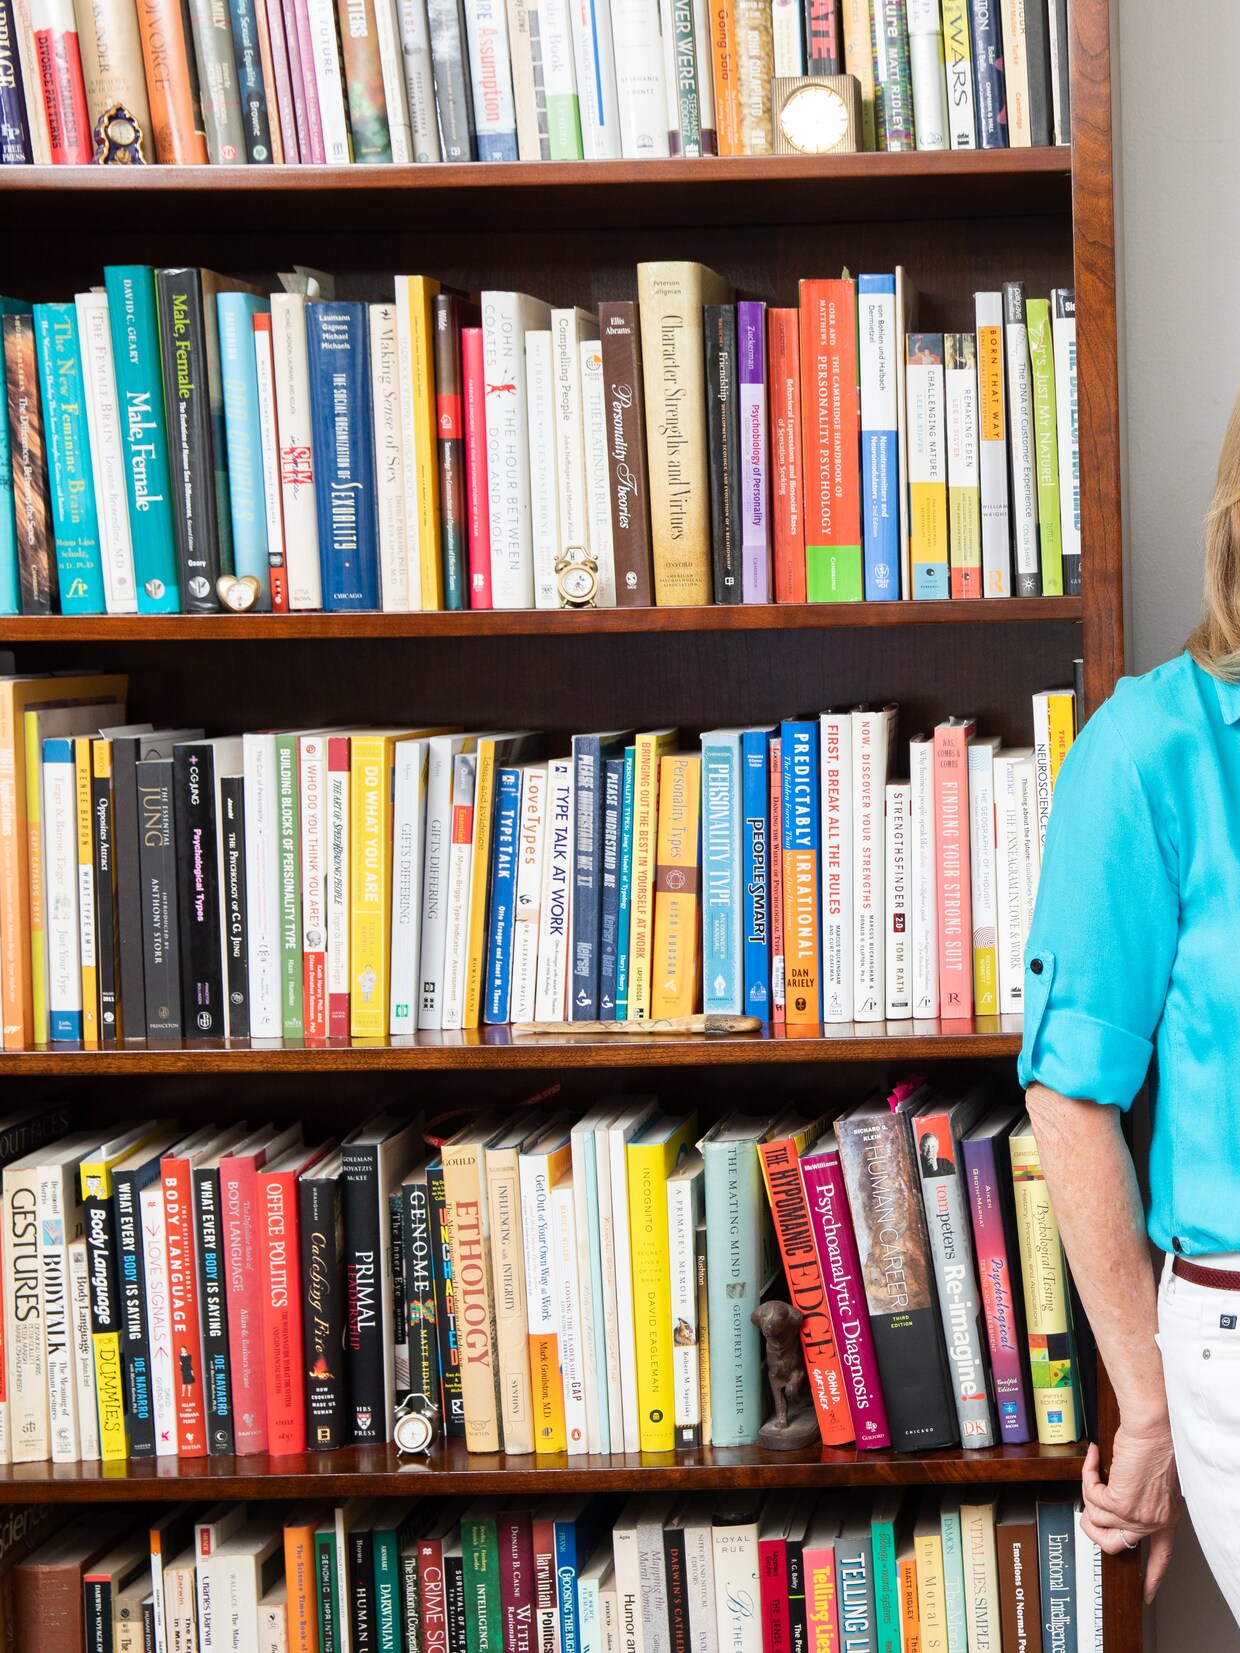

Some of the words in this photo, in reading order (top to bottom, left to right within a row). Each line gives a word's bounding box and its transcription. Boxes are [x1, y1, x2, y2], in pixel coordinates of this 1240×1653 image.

[241, 17, 252, 46] Sexual
[717, 10, 728, 48] Going
[242, 50, 255, 87] Equality
[479, 28, 503, 122] Assumption
[721, 53, 730, 80] Solo
[888, 48, 899, 80] MATT
[950, 14, 967, 106] WARS
[38, 36, 51, 87] DIVORCE
[46, 89, 61, 148] PATTERNS
[677, 38, 694, 90] WERE
[688, 93, 698, 140] STEPHANIE
[891, 85, 902, 131] RIDLEY
[681, 99, 691, 136] COONTZ
[123, 280, 134, 312] DAVID
[172, 294, 188, 337] Male,
[54, 321, 71, 352] The
[128, 327, 138, 364] GEARY
[660, 315, 684, 384] Character
[747, 326, 756, 370] Zuckerman
[58, 358, 75, 396] New
[177, 341, 194, 398] Female
[333, 374, 345, 387] THE
[718, 352, 729, 401] Friendship
[126, 390, 157, 442] Male,
[334, 389, 347, 414] SOCIAL
[504, 408, 516, 436] THE
[611, 384, 632, 462] Personality
[658, 388, 689, 456] Strengths
[818, 356, 829, 446] PERSONALITY
[833, 376, 841, 430] CAMBRIDGE
[61, 403, 79, 473] Feminine
[335, 417, 350, 467] ORGANIZATION
[489, 428, 499, 461] DOG
[750, 405, 761, 466] Psychobiology
[834, 432, 842, 483] HANDBOOK
[133, 444, 162, 511] Female
[338, 470, 350, 479] OF
[491, 472, 500, 503] AND
[506, 445, 517, 489] HOUR
[667, 460, 688, 485] and
[754, 467, 761, 477] of
[871, 436, 879, 499] Neuromodulators
[880, 436, 888, 500] Neurotransmitters
[69, 480, 85, 523] Brain
[617, 463, 638, 529] Theories
[752, 478, 762, 526] Personality
[819, 449, 831, 534] PSYCHOLOGY
[835, 486, 842, 497] OF
[331, 482, 363, 549] SEXUALITY
[492, 511, 502, 556] WOLF
[507, 498, 519, 570] BETWEEN
[669, 490, 691, 540] Virtues
[827, 724, 838, 764] FIRST,
[280, 749, 292, 794] BUILDING
[365, 766, 378, 786] DO
[793, 733, 811, 846] PREDICTABLY
[828, 769, 839, 813] BREAK
[98, 798, 108, 840] Opposites
[138, 786, 163, 848] JUNG
[282, 797, 293, 835] BLOCKS
[365, 790, 378, 834] WHAT
[523, 774, 543, 864] LoveTypes
[555, 786, 569, 820] TYPE
[709, 764, 731, 863] PERSONALITY
[942, 781, 958, 837] FINDING
[283, 838, 294, 850] OF
[553, 826, 568, 861] TALK
[828, 817, 839, 840] ALL
[894, 792, 905, 908] STRENGTHSFINDER
[101, 842, 109, 870] Attract
[193, 829, 204, 891] Psychological
[229, 850, 239, 898] PSYCHOLOGY
[365, 837, 378, 868] YOU
[552, 865, 566, 883] AT
[829, 843, 840, 870] THE
[943, 843, 959, 877] YOUR
[151, 878, 162, 927] ANTHONY
[195, 894, 205, 921] Types
[232, 901, 239, 911] OF
[283, 853, 295, 921] PERSONALITY
[364, 872, 378, 902] ARE
[709, 869, 730, 906] TYPE
[797, 855, 813, 958] IRRATIONAL
[829, 873, 840, 915] RULES
[943, 883, 961, 934] STRONG
[233, 924, 241, 933] G.
[550, 888, 566, 935] WORK
[895, 916, 904, 928] 2.0
[154, 928, 162, 963] STORR
[231, 936, 243, 957] JUNG
[285, 924, 296, 949] TYPE
[895, 941, 903, 962] TOM
[946, 941, 962, 971] SUIT
[787, 979, 815, 987] ARIELY
[792, 968, 809, 976] DAN
[896, 968, 904, 993] RATH
[728, 1148, 738, 1174] THE
[118, 1183, 133, 1215] WHAT
[165, 1178, 179, 1225] BODY
[642, 1167, 653, 1233] INCOGNITO
[866, 1146, 895, 1223] HUMAN
[90, 1209, 105, 1247] Body
[266, 1183, 283, 1236] OFFICE
[729, 1180, 738, 1236] MATING
[936, 1184, 958, 1260] tompeters
[11, 1188, 40, 1322] GESTURES
[121, 1217, 135, 1251] EVERY
[410, 1191, 430, 1292] GENOME
[1034, 1202, 1052, 1269] Psychological
[124, 1255, 137, 1281] BODY
[269, 1242, 287, 1308] POLITICS
[308, 1232, 329, 1313] Catching
[731, 1240, 740, 1277] MIND
[880, 1228, 909, 1308] CAREER
[42, 1254, 67, 1355] BODYTALK
[93, 1249, 111, 1324] Language
[126, 1285, 138, 1296] IS
[168, 1236, 186, 1332] LANGUAGE
[355, 1251, 376, 1332] PRIMAL
[455, 1199, 490, 1369] ETHOLOGY
[815, 1184, 855, 1315] Psychoanalytic
[839, 1320, 872, 1409] Diagnosis
[991, 1258, 1014, 1350] Psychological
[1041, 1273, 1057, 1312] Testing
[127, 1299, 141, 1339] SAYING
[648, 1292, 657, 1327] DAVID
[315, 1315, 330, 1353] Fire
[539, 1342, 550, 1361] Mark
[943, 1264, 986, 1402] Re-imagine!
[134, 1357, 146, 1373] JOE
[540, 1364, 552, 1402] Goulston,
[649, 1331, 659, 1393] EAGLEMAN
[135, 1375, 149, 1419] NAVARRO
[542, 1401, 552, 1419] M.D.
[321, 1554, 330, 1593] GENOMIC
[536, 1554, 553, 1608] Darwinian
[1048, 1534, 1069, 1590] Emotional
[810, 1566, 834, 1621] Telling
[841, 1552, 869, 1631] TELLING
[323, 1599, 331, 1652] IMPRINTING
[542, 1612, 554, 1653] Politics
[1046, 1597, 1070, 1653] Intelligence
